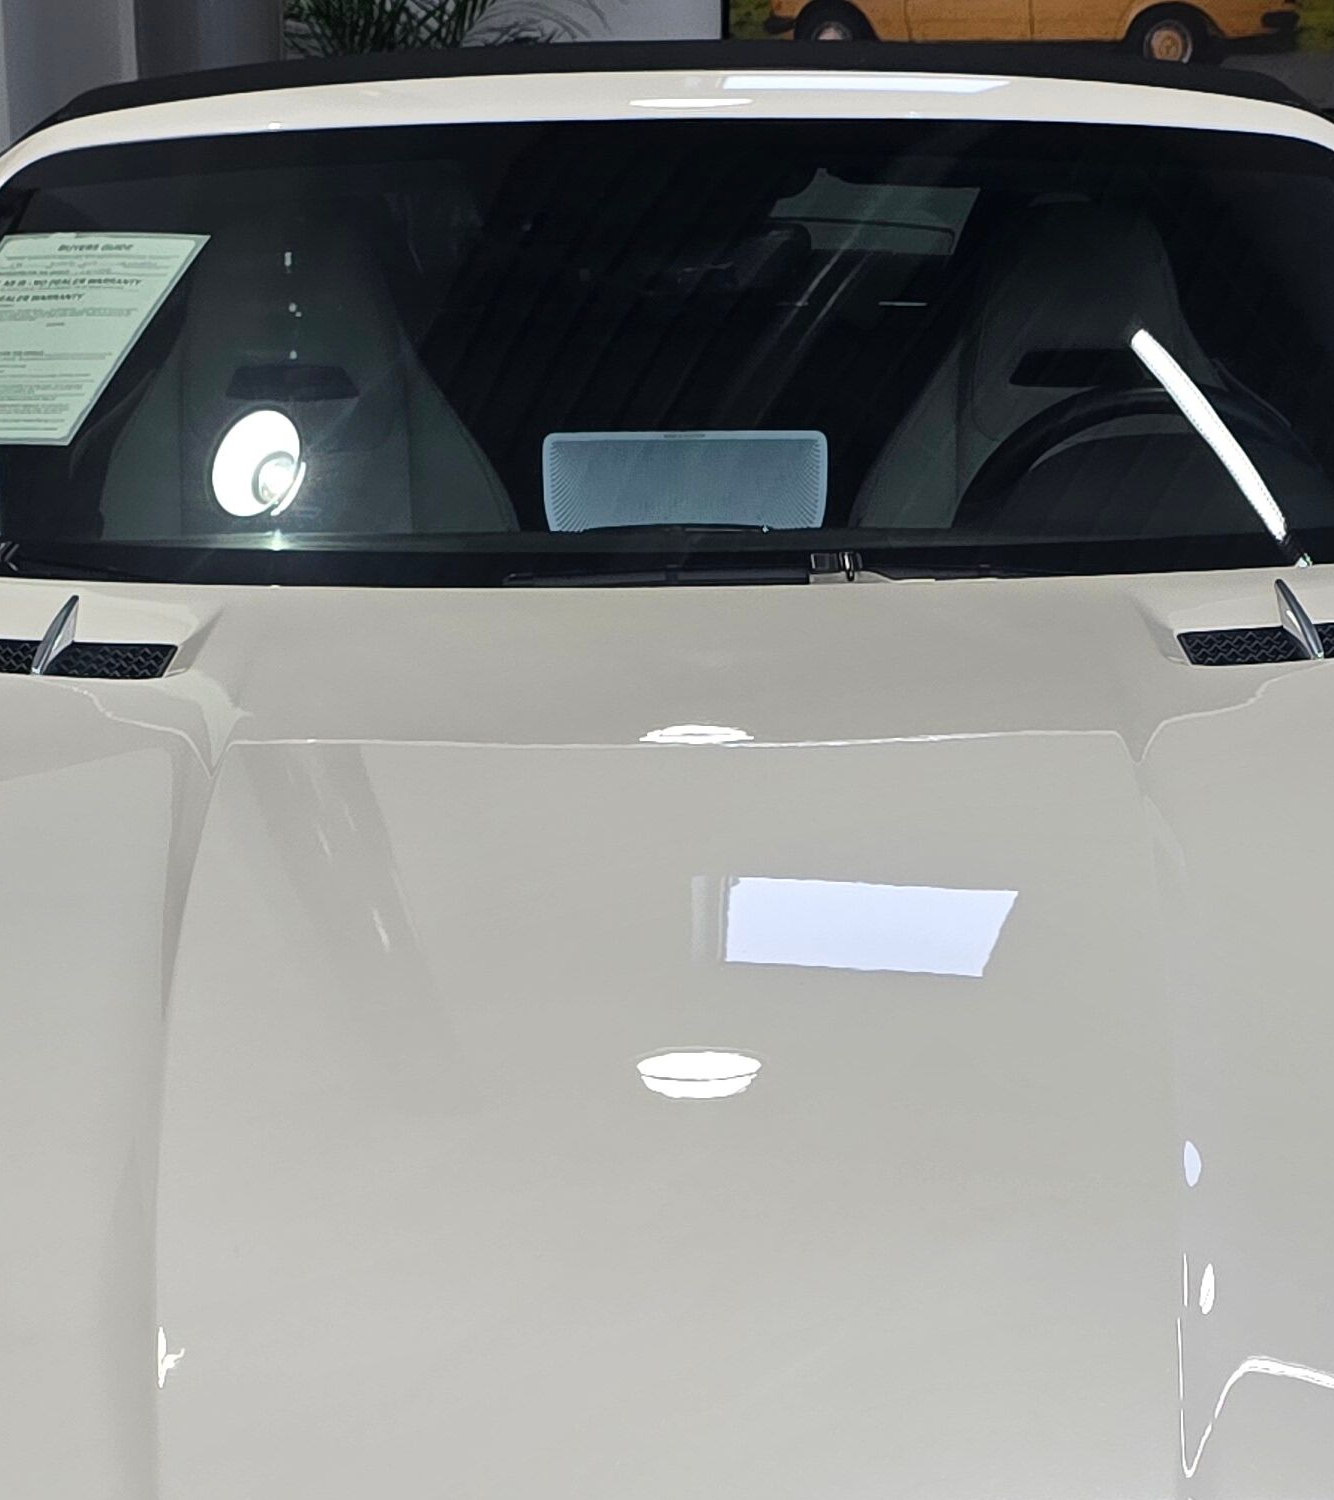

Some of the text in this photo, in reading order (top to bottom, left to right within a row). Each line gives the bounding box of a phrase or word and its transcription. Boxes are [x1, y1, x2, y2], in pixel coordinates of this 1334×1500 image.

[101, 244, 134, 252] GUIDE
[33, 279, 48, 287] NO
[48, 278, 86, 287] DEALER
[87, 278, 142, 286] WARRANTY
[31, 293, 85, 302] WARRANTY
